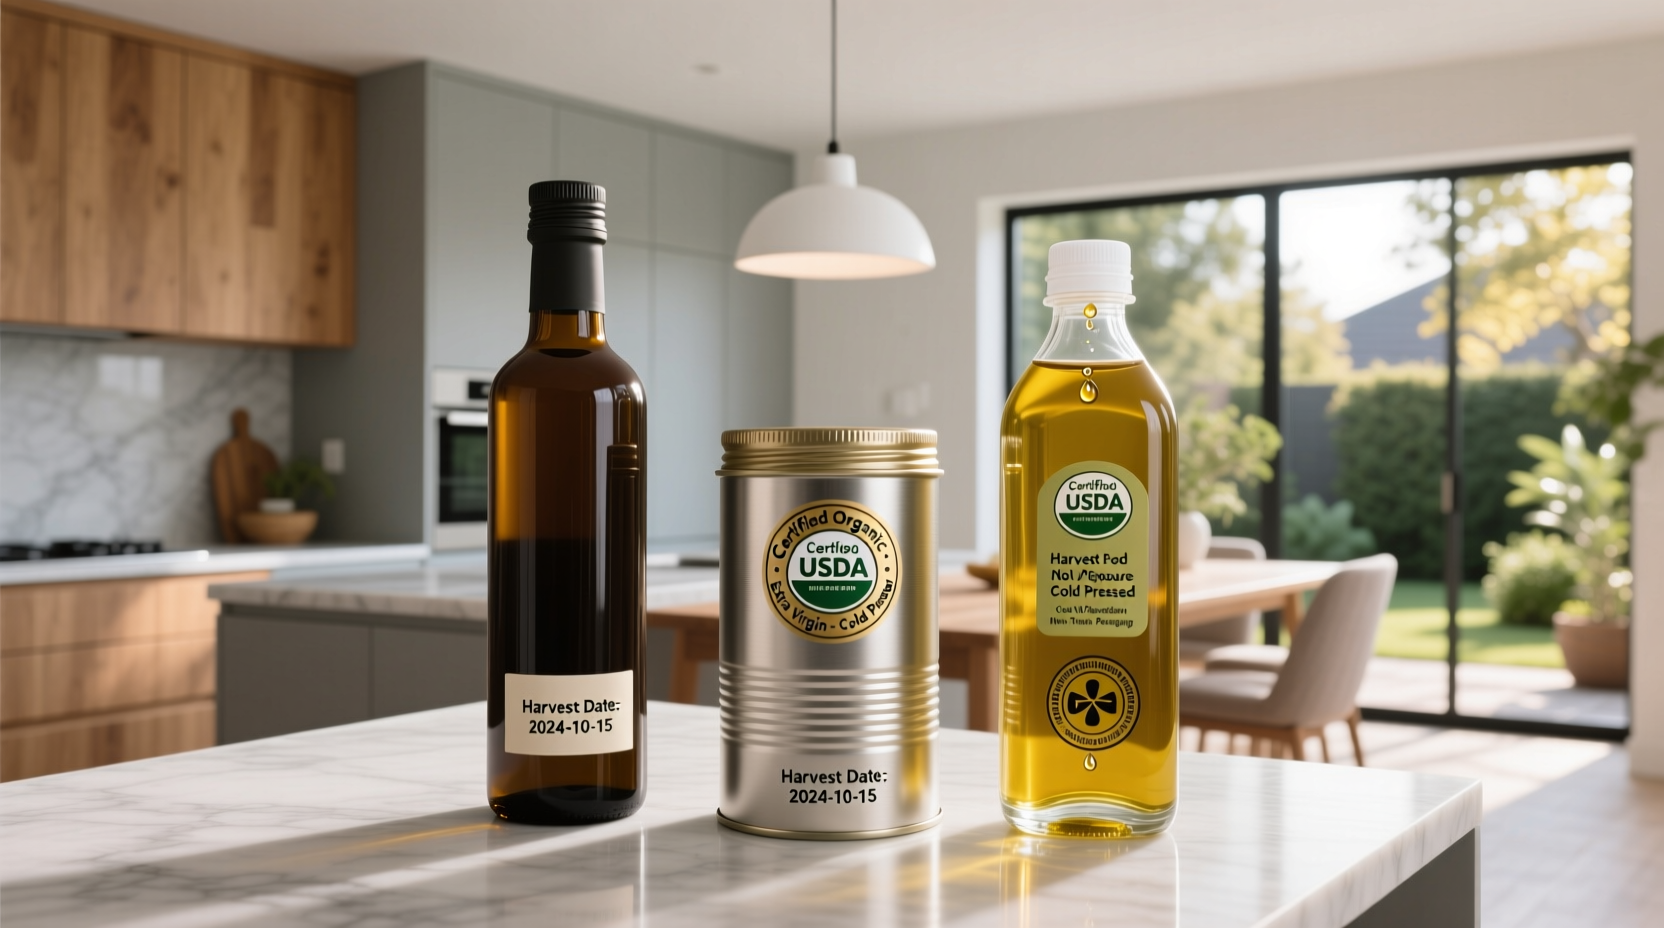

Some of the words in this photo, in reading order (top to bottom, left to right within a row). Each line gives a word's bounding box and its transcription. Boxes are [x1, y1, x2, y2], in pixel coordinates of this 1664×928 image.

[1066, 493, 1124, 511] USDA
[833, 510, 888, 553] Organic
[799, 557, 869, 578] USDA
[1050, 584, 1080, 597] Cold
[1084, 584, 1136, 598] Pressed
[792, 607, 827, 632] Virgin
[839, 610, 869, 630] Cold
[522, 699, 580, 714] Harvest
[584, 698, 621, 713] Date:
[529, 718, 613, 734] 2024-10-15
[781, 769, 842, 784] Harvest
[847, 769, 887, 784] Date:
[789, 788, 877, 804] 2024-10-15
